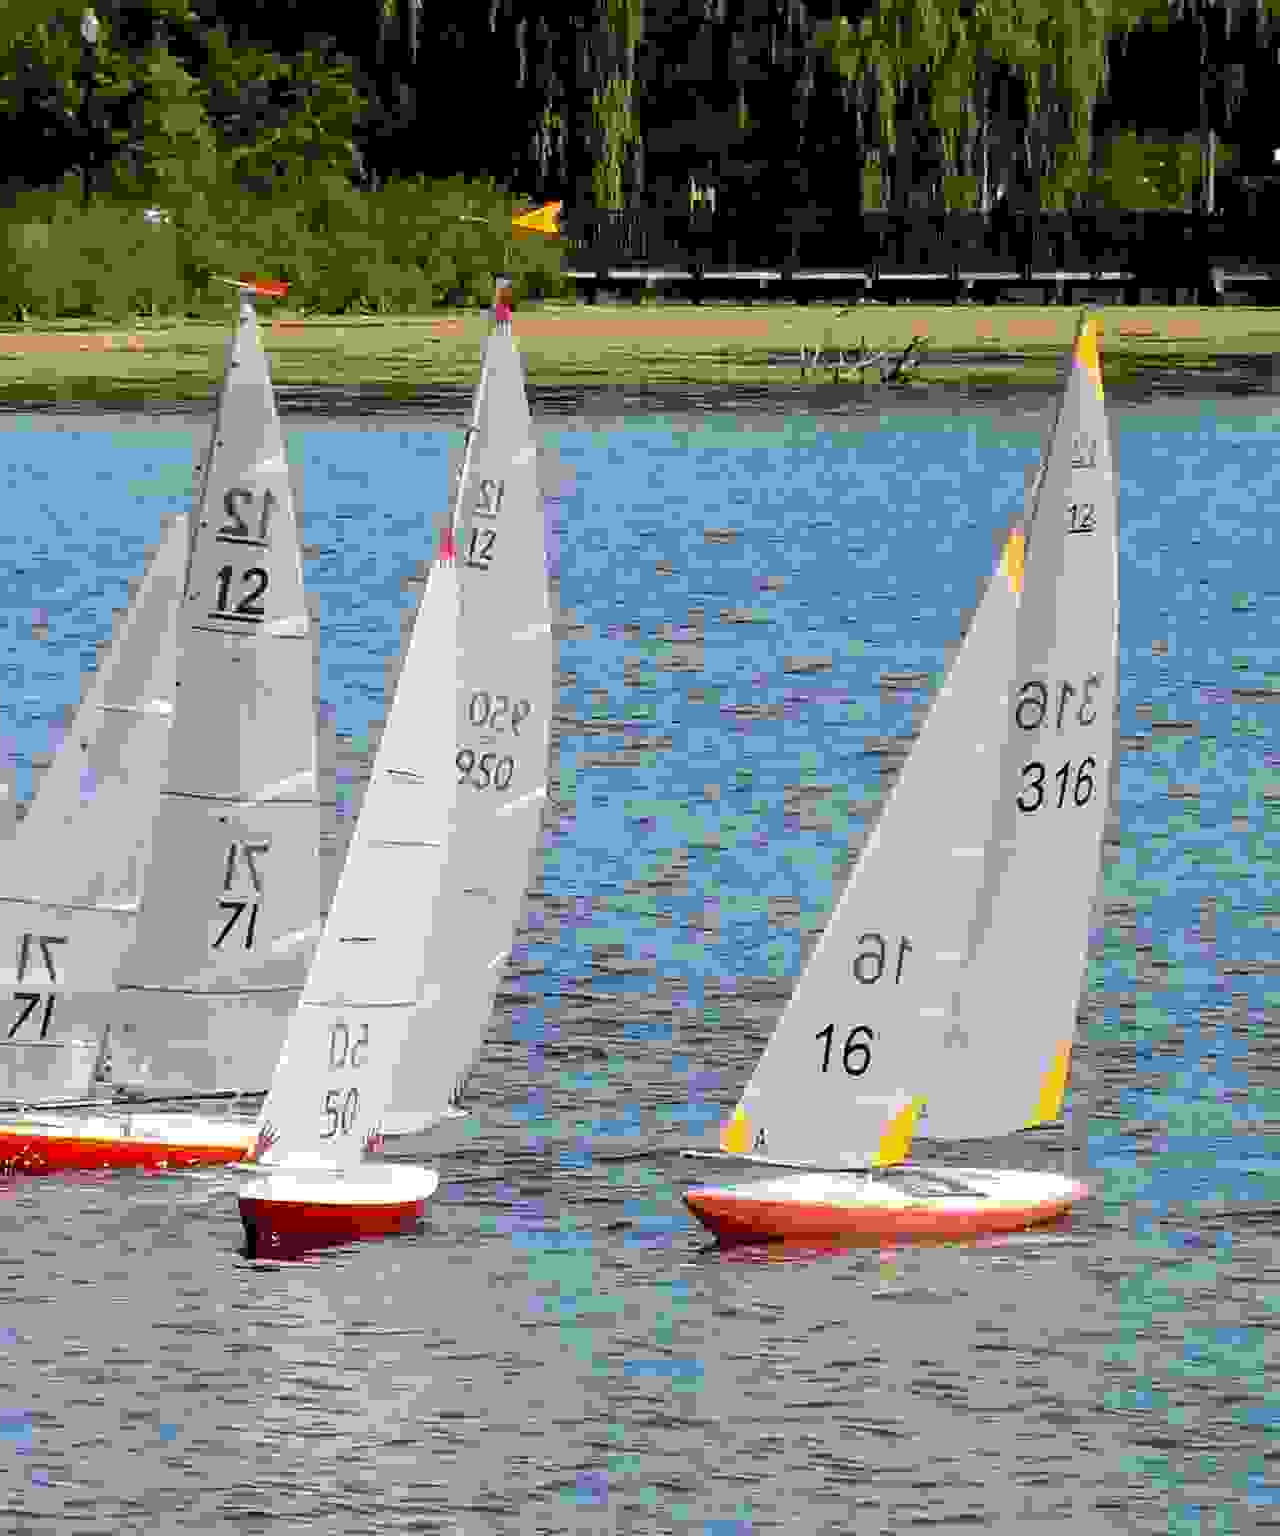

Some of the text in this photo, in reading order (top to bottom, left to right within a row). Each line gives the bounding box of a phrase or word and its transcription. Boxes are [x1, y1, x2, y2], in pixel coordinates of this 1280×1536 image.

[1065, 504, 1096, 528] 12
[466, 528, 497, 561] 12
[216, 564, 270, 614] 12
[456, 747, 516, 791] 950
[1017, 756, 1097, 813] 316
[210, 900, 262, 951] 71
[8, 991, 56, 1039] 71
[816, 1022, 876, 1077] 16
[322, 1088, 360, 1139] 50
